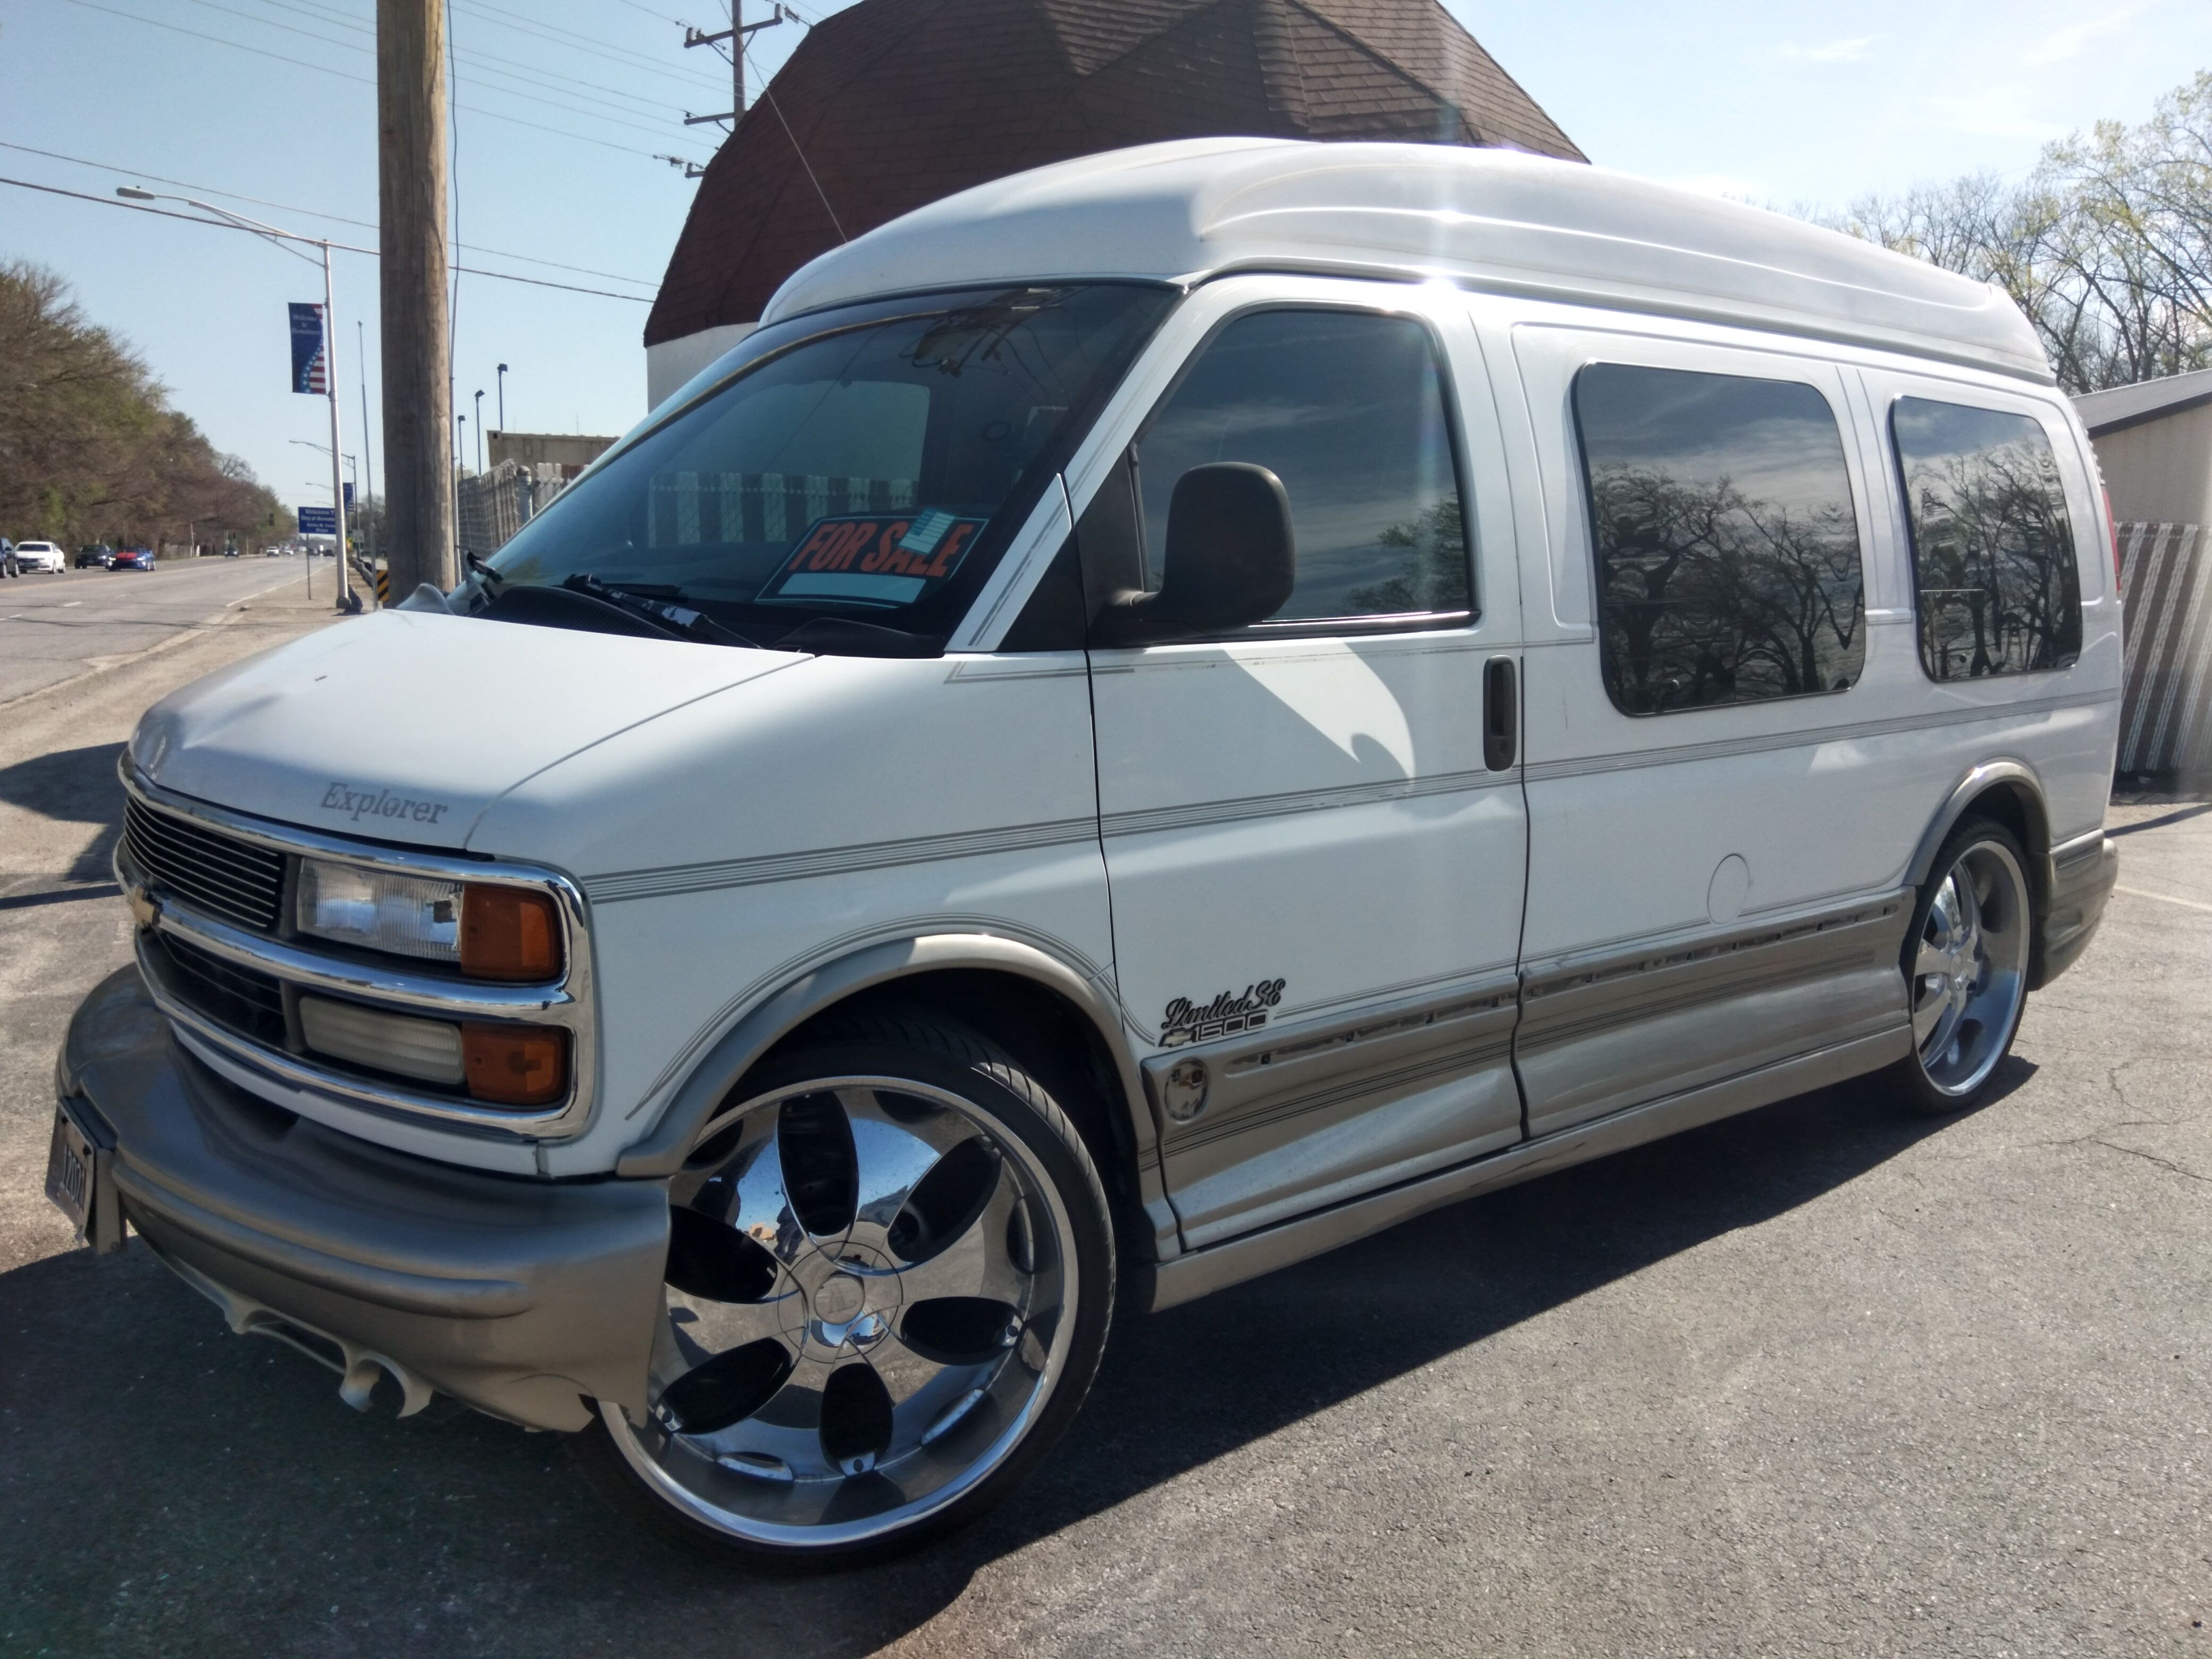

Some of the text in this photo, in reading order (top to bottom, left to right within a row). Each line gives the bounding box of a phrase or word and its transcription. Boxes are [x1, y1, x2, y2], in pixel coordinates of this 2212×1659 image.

[787, 522, 878, 571] FOR
[321, 782, 449, 824] Explorer
[1161, 978, 1287, 1030] Limited SE
[1193, 1009, 1269, 1042] 1500
